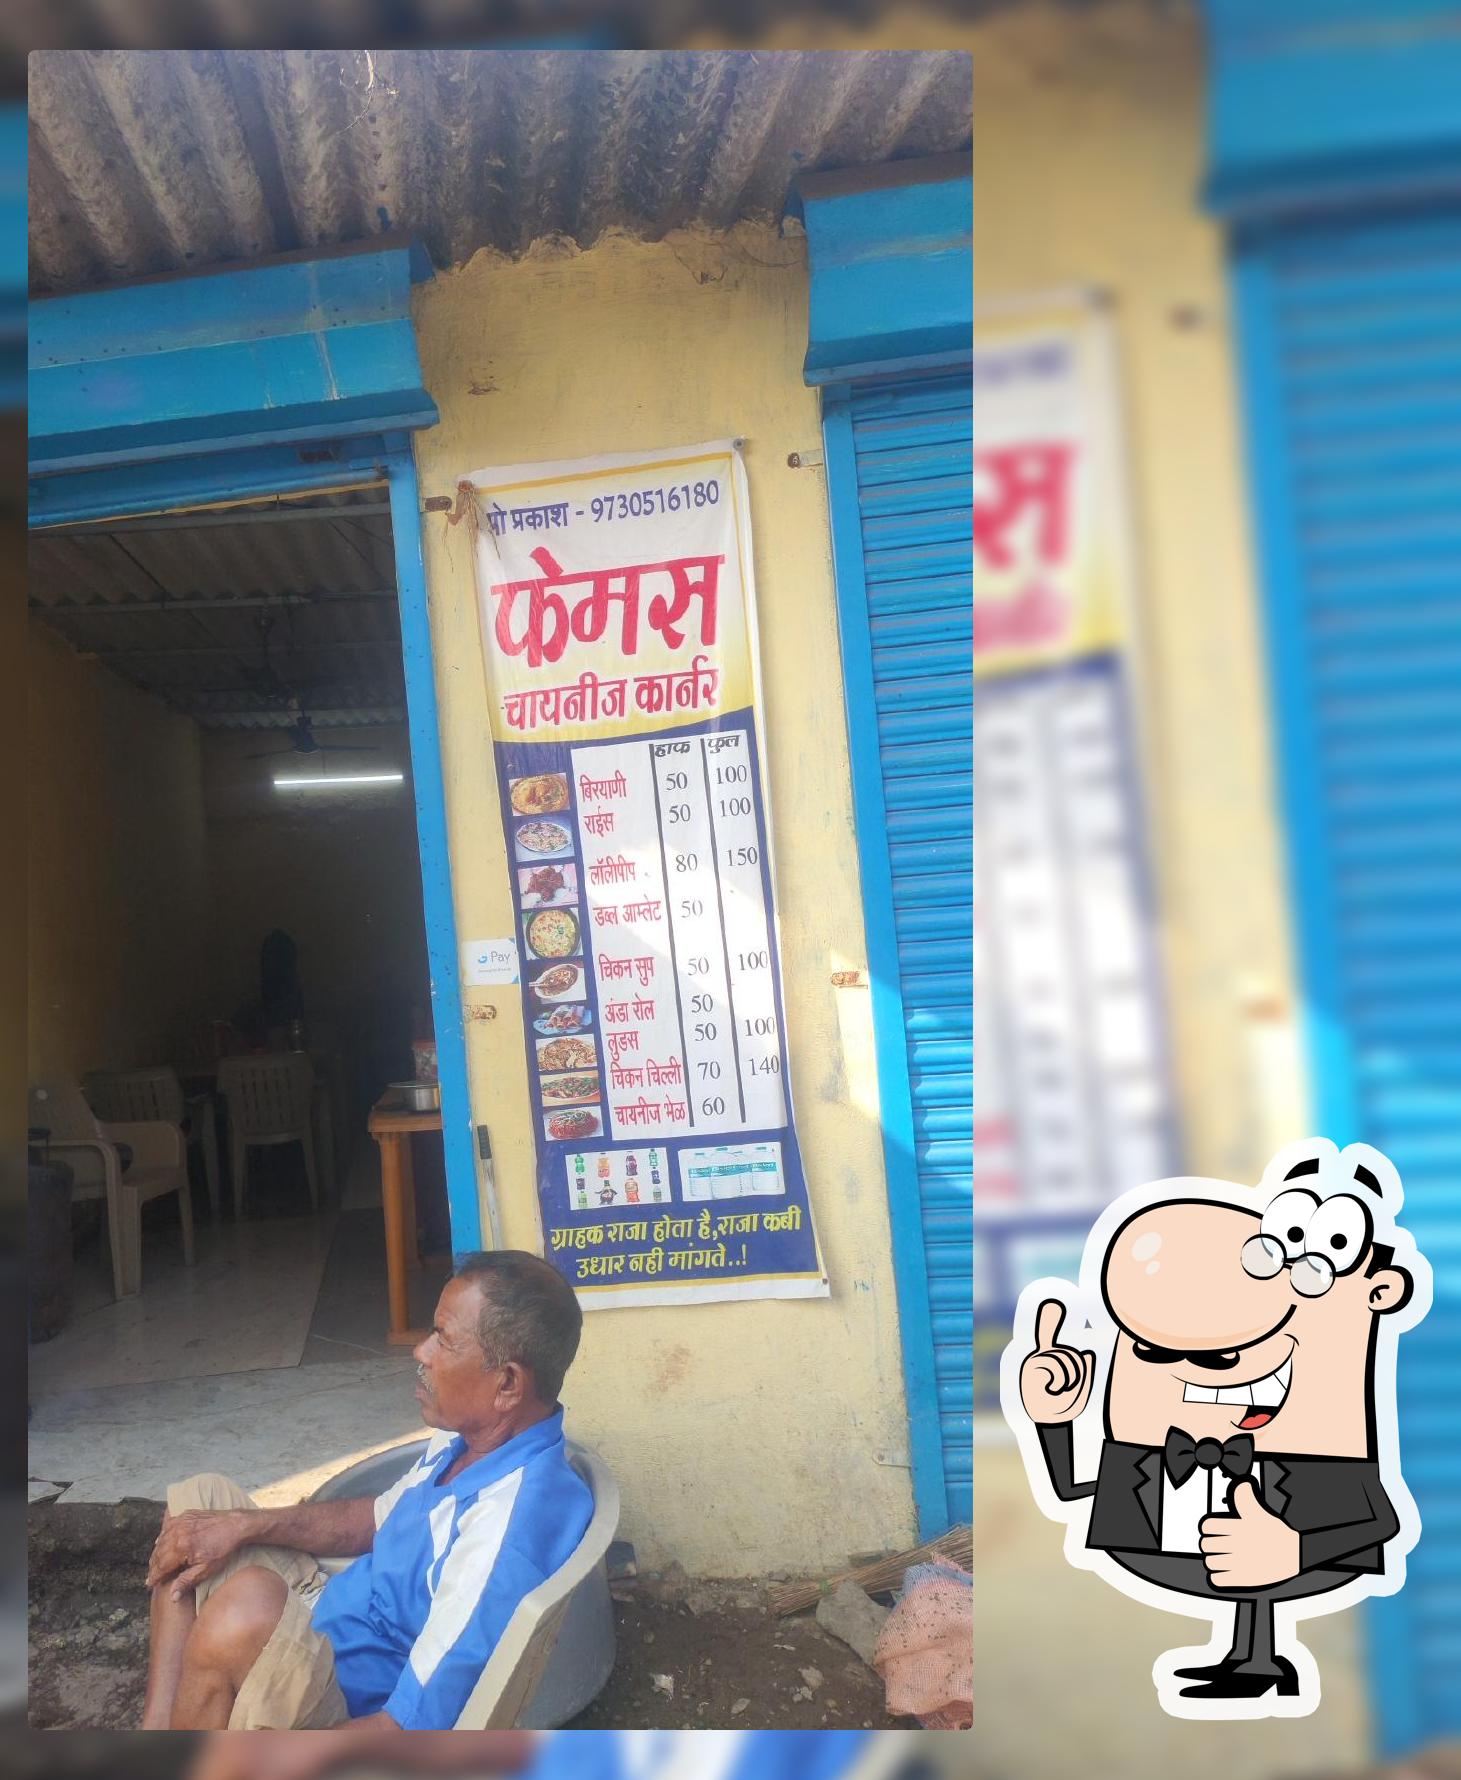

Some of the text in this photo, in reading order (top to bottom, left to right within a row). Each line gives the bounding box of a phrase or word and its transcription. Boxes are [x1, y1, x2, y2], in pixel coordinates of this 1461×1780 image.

[510, 503, 569, 531] प्रकाश
[591, 480, 719, 522] 9730516180
[490, 546, 725, 667] फेमस
[504, 654, 719, 730] चायनीज कार्नर
[655, 735, 741, 757] हाफ फुल
[580, 765, 747, 802] बिरयाणी 50 100
[669, 803, 691, 823] 50
[720, 797, 751, 817] 100
[676, 853, 698, 872] 80
[727, 847, 757, 866] 150
[681, 900, 703, 918] 50
[491, 951, 511, 965] Pay
[599, 951, 768, 986] चिकन सुप 50 100
[605, 992, 713, 1023] अंडा रोल 50
[695, 1022, 717, 1041] 50
[745, 1017, 775, 1036] 100
[610, 1055, 779, 1089] चिकन चिल्ली 70 140
[614, 1096, 660, 1125] चायनीज
[702, 1096, 724, 1116] 60
[550, 1225, 604, 1251] ग्राहक
[606, 1222, 648, 1242] राजा
[652, 1215, 694, 1242] होता
[576, 1254, 626, 1278] उधार
[628, 1247, 664, 1275] नही
